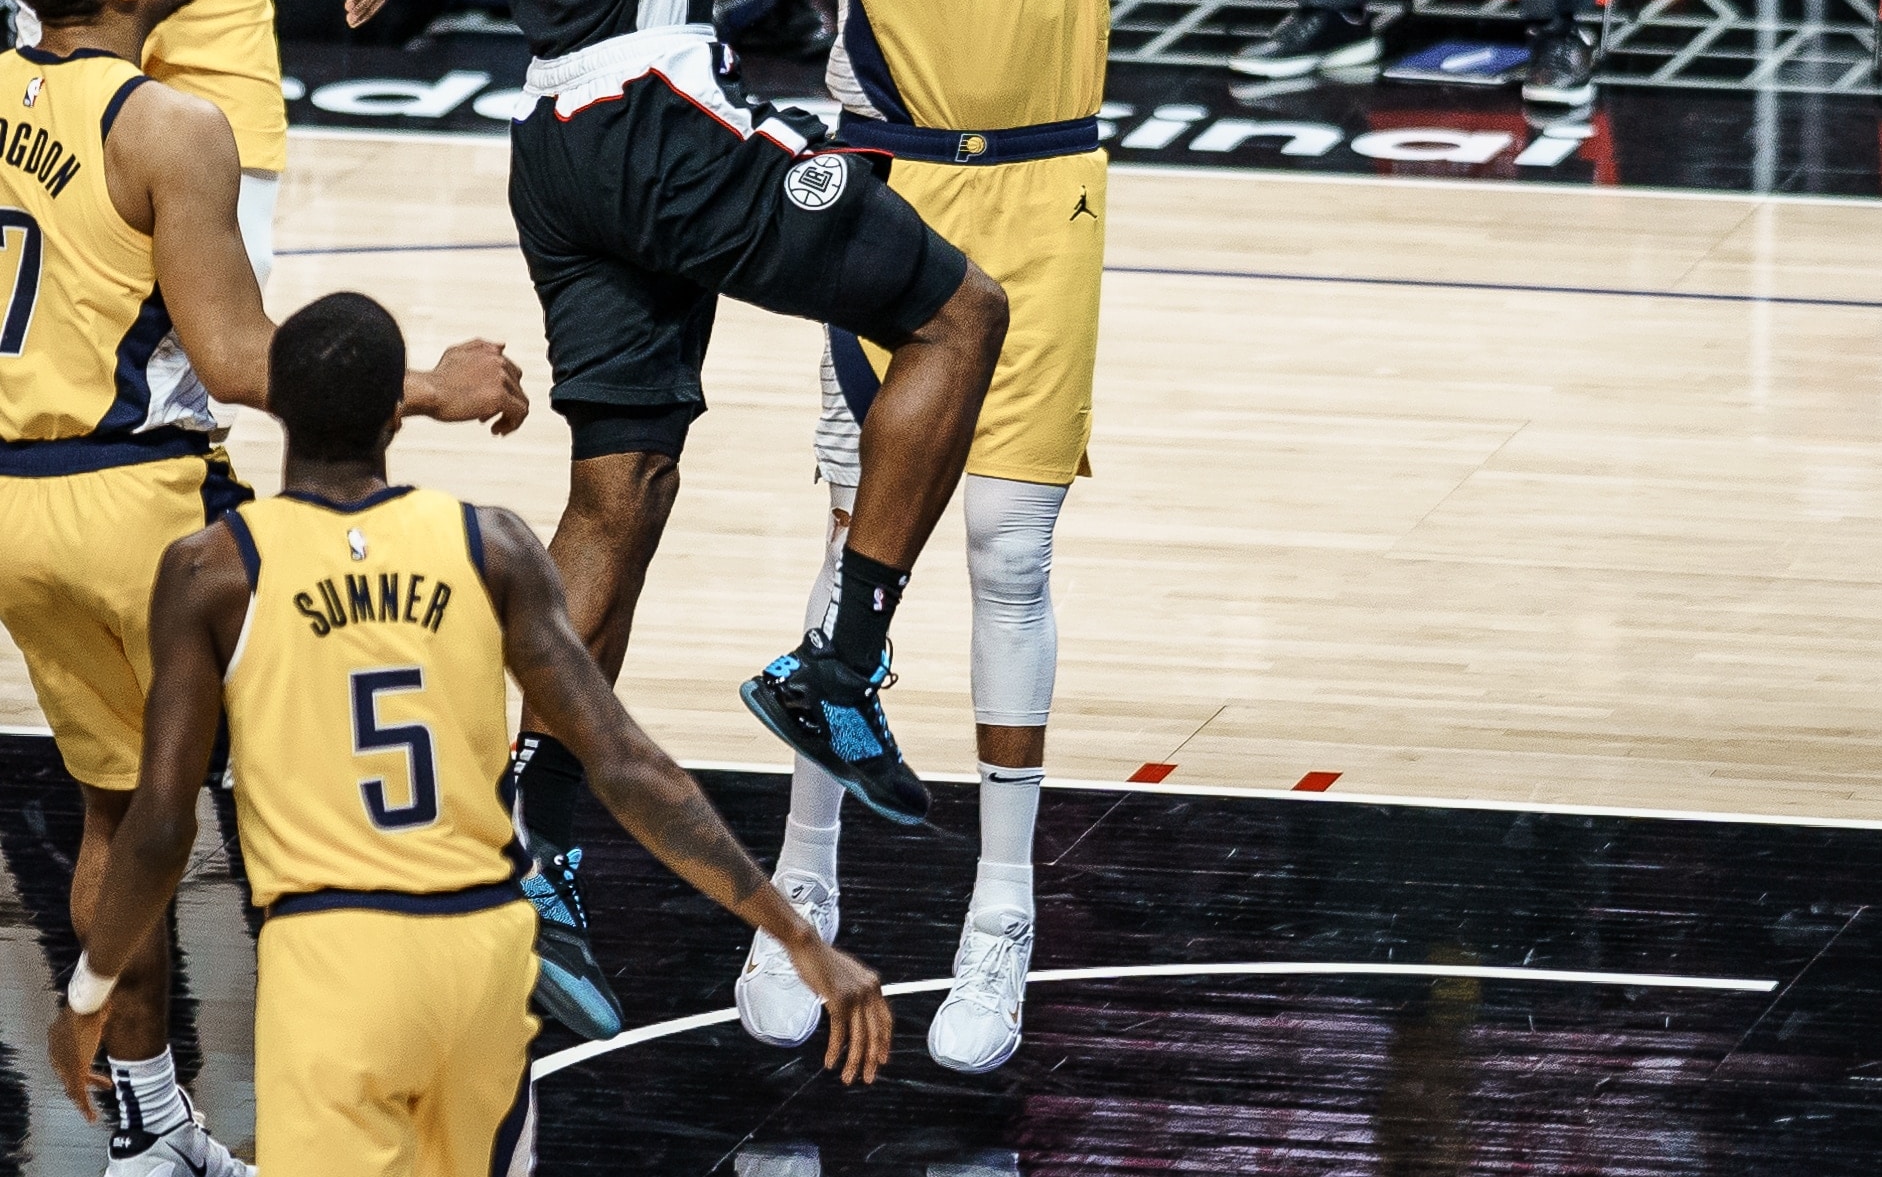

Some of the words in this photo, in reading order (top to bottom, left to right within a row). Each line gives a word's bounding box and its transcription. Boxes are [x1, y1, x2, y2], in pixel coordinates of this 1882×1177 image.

[0, 205, 44, 358] 7
[292, 573, 453, 639] SUMNER
[347, 665, 440, 834] 5
